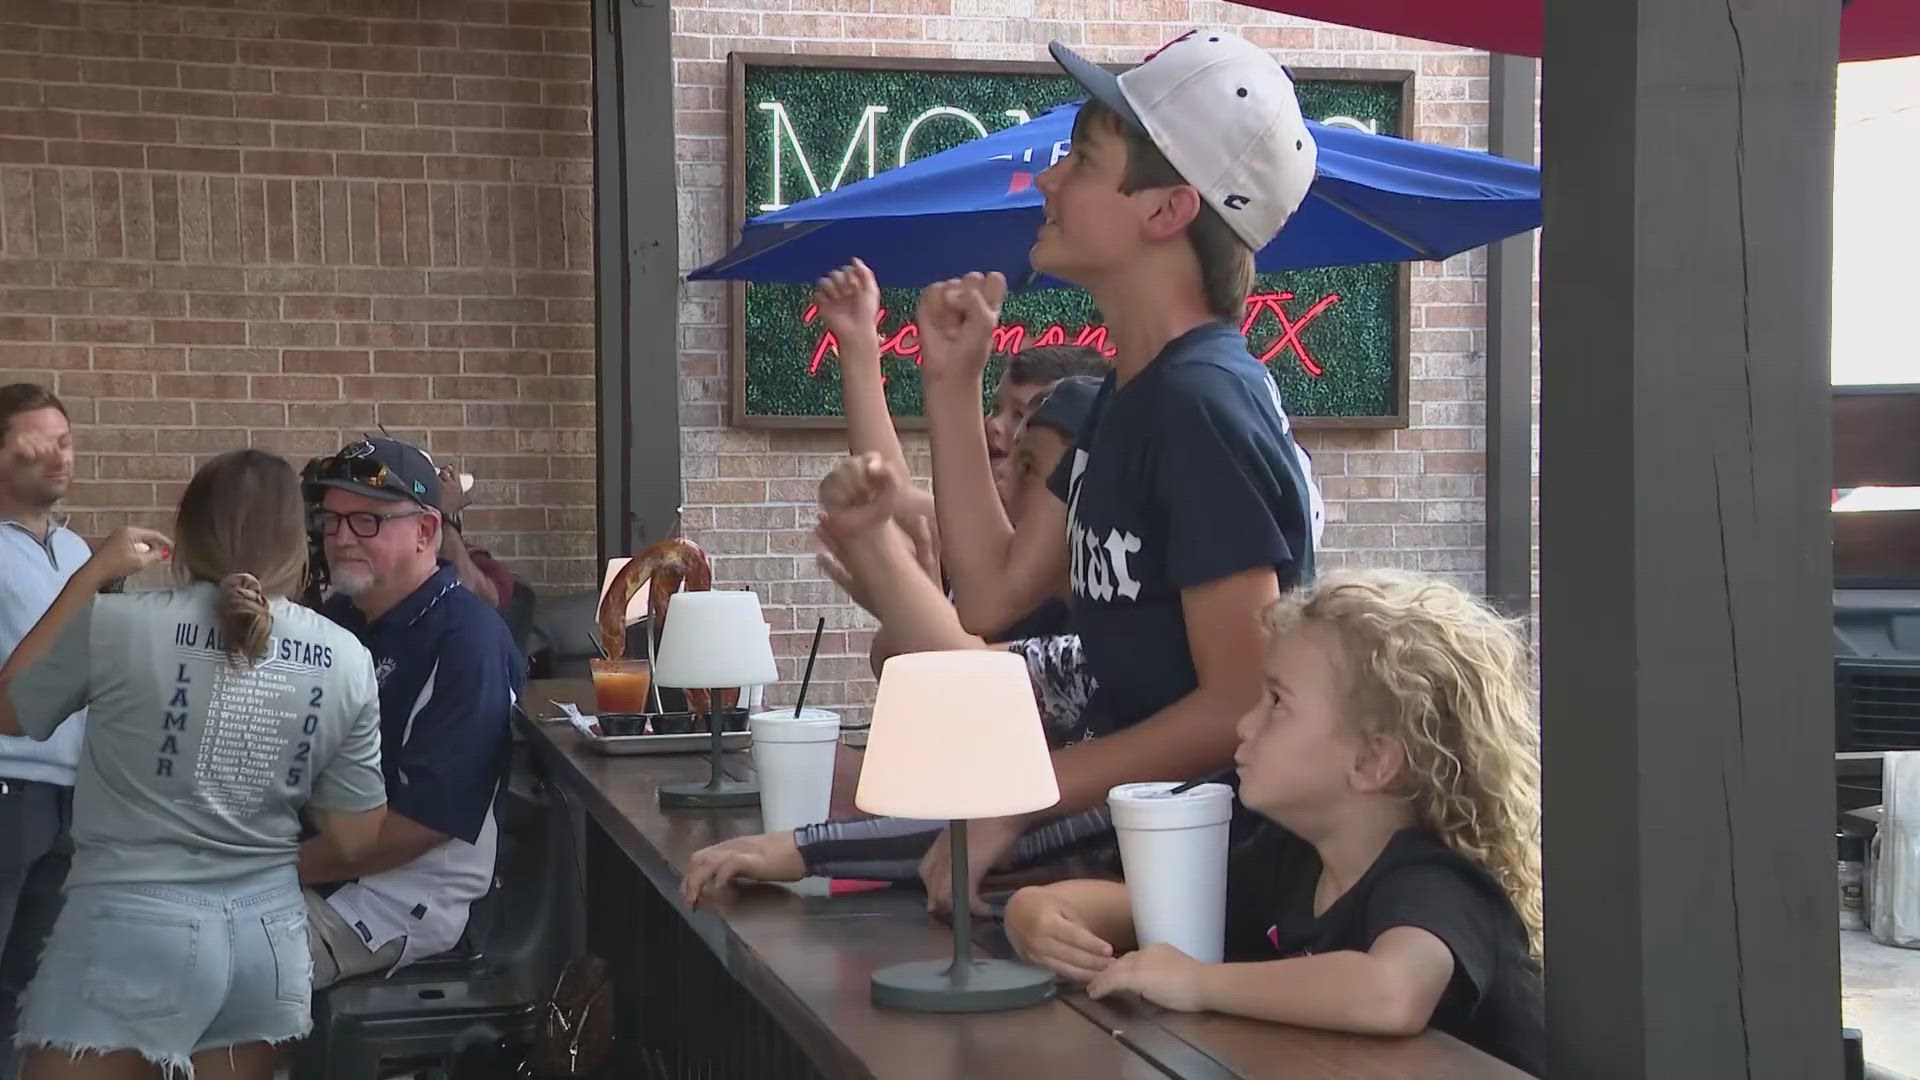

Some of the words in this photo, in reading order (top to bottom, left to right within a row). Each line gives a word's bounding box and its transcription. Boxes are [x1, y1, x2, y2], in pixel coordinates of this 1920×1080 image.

[280, 637, 333, 669] STARS
[156, 663, 191, 778] LAMAR
[220, 711, 250, 721] WYATT
[285, 686, 324, 788] 2025
